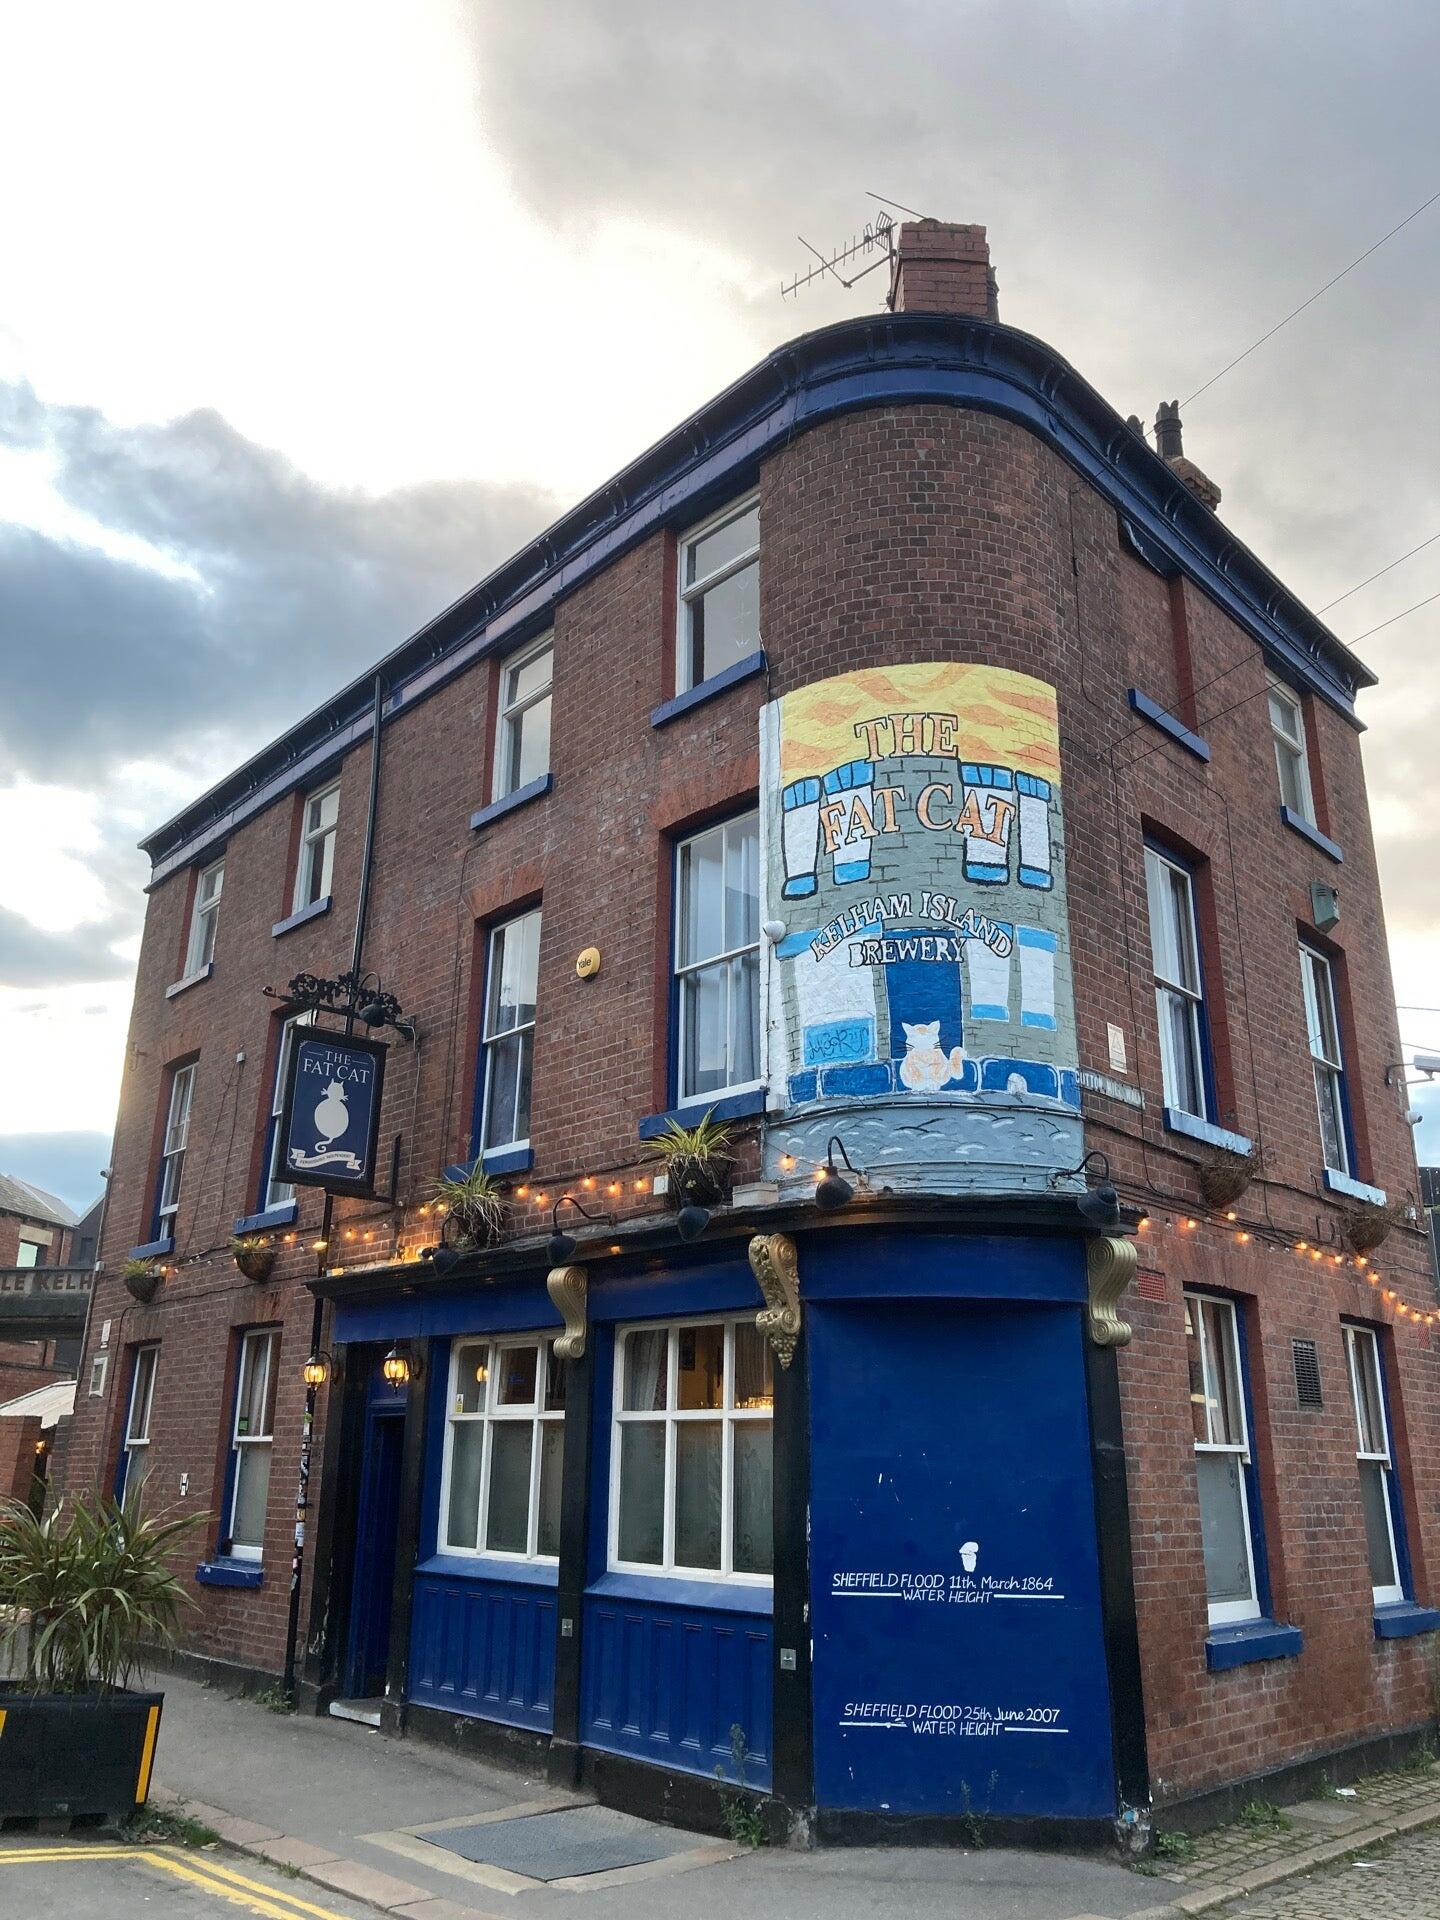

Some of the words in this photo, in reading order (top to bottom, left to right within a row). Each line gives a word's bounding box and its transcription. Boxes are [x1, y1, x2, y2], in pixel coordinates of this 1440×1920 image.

[854, 712, 958, 763] THE
[819, 785, 906, 855] FAT
[915, 782, 1016, 847] CAT
[809, 893, 913, 962] KELHAM
[919, 891, 1014, 958] ISLAND
[848, 937, 968, 968] BREWERY
[578, 957, 592, 969] Yale
[325, 1050, 352, 1066] THE
[303, 1057, 334, 1076] FAT
[336, 1065, 370, 1084] CAT
[832, 1572, 899, 1588] SHEFFIELD
[900, 1573, 945, 1589] FLOOD
[981, 1576, 1021, 1591] March
[1021, 1577, 1054, 1591] 1864
[903, 1588, 945, 1602] WATER
[948, 1590, 993, 1604] HEIGHT
[844, 1703, 917, 1718] SHEFFIELD
[919, 1704, 962, 1720] FLOOD
[994, 1706, 1025, 1721] June
[1026, 1707, 1060, 1723] 2007
[912, 1721, 956, 1735] WATER
[959, 1721, 1003, 1737] HEIGHT
